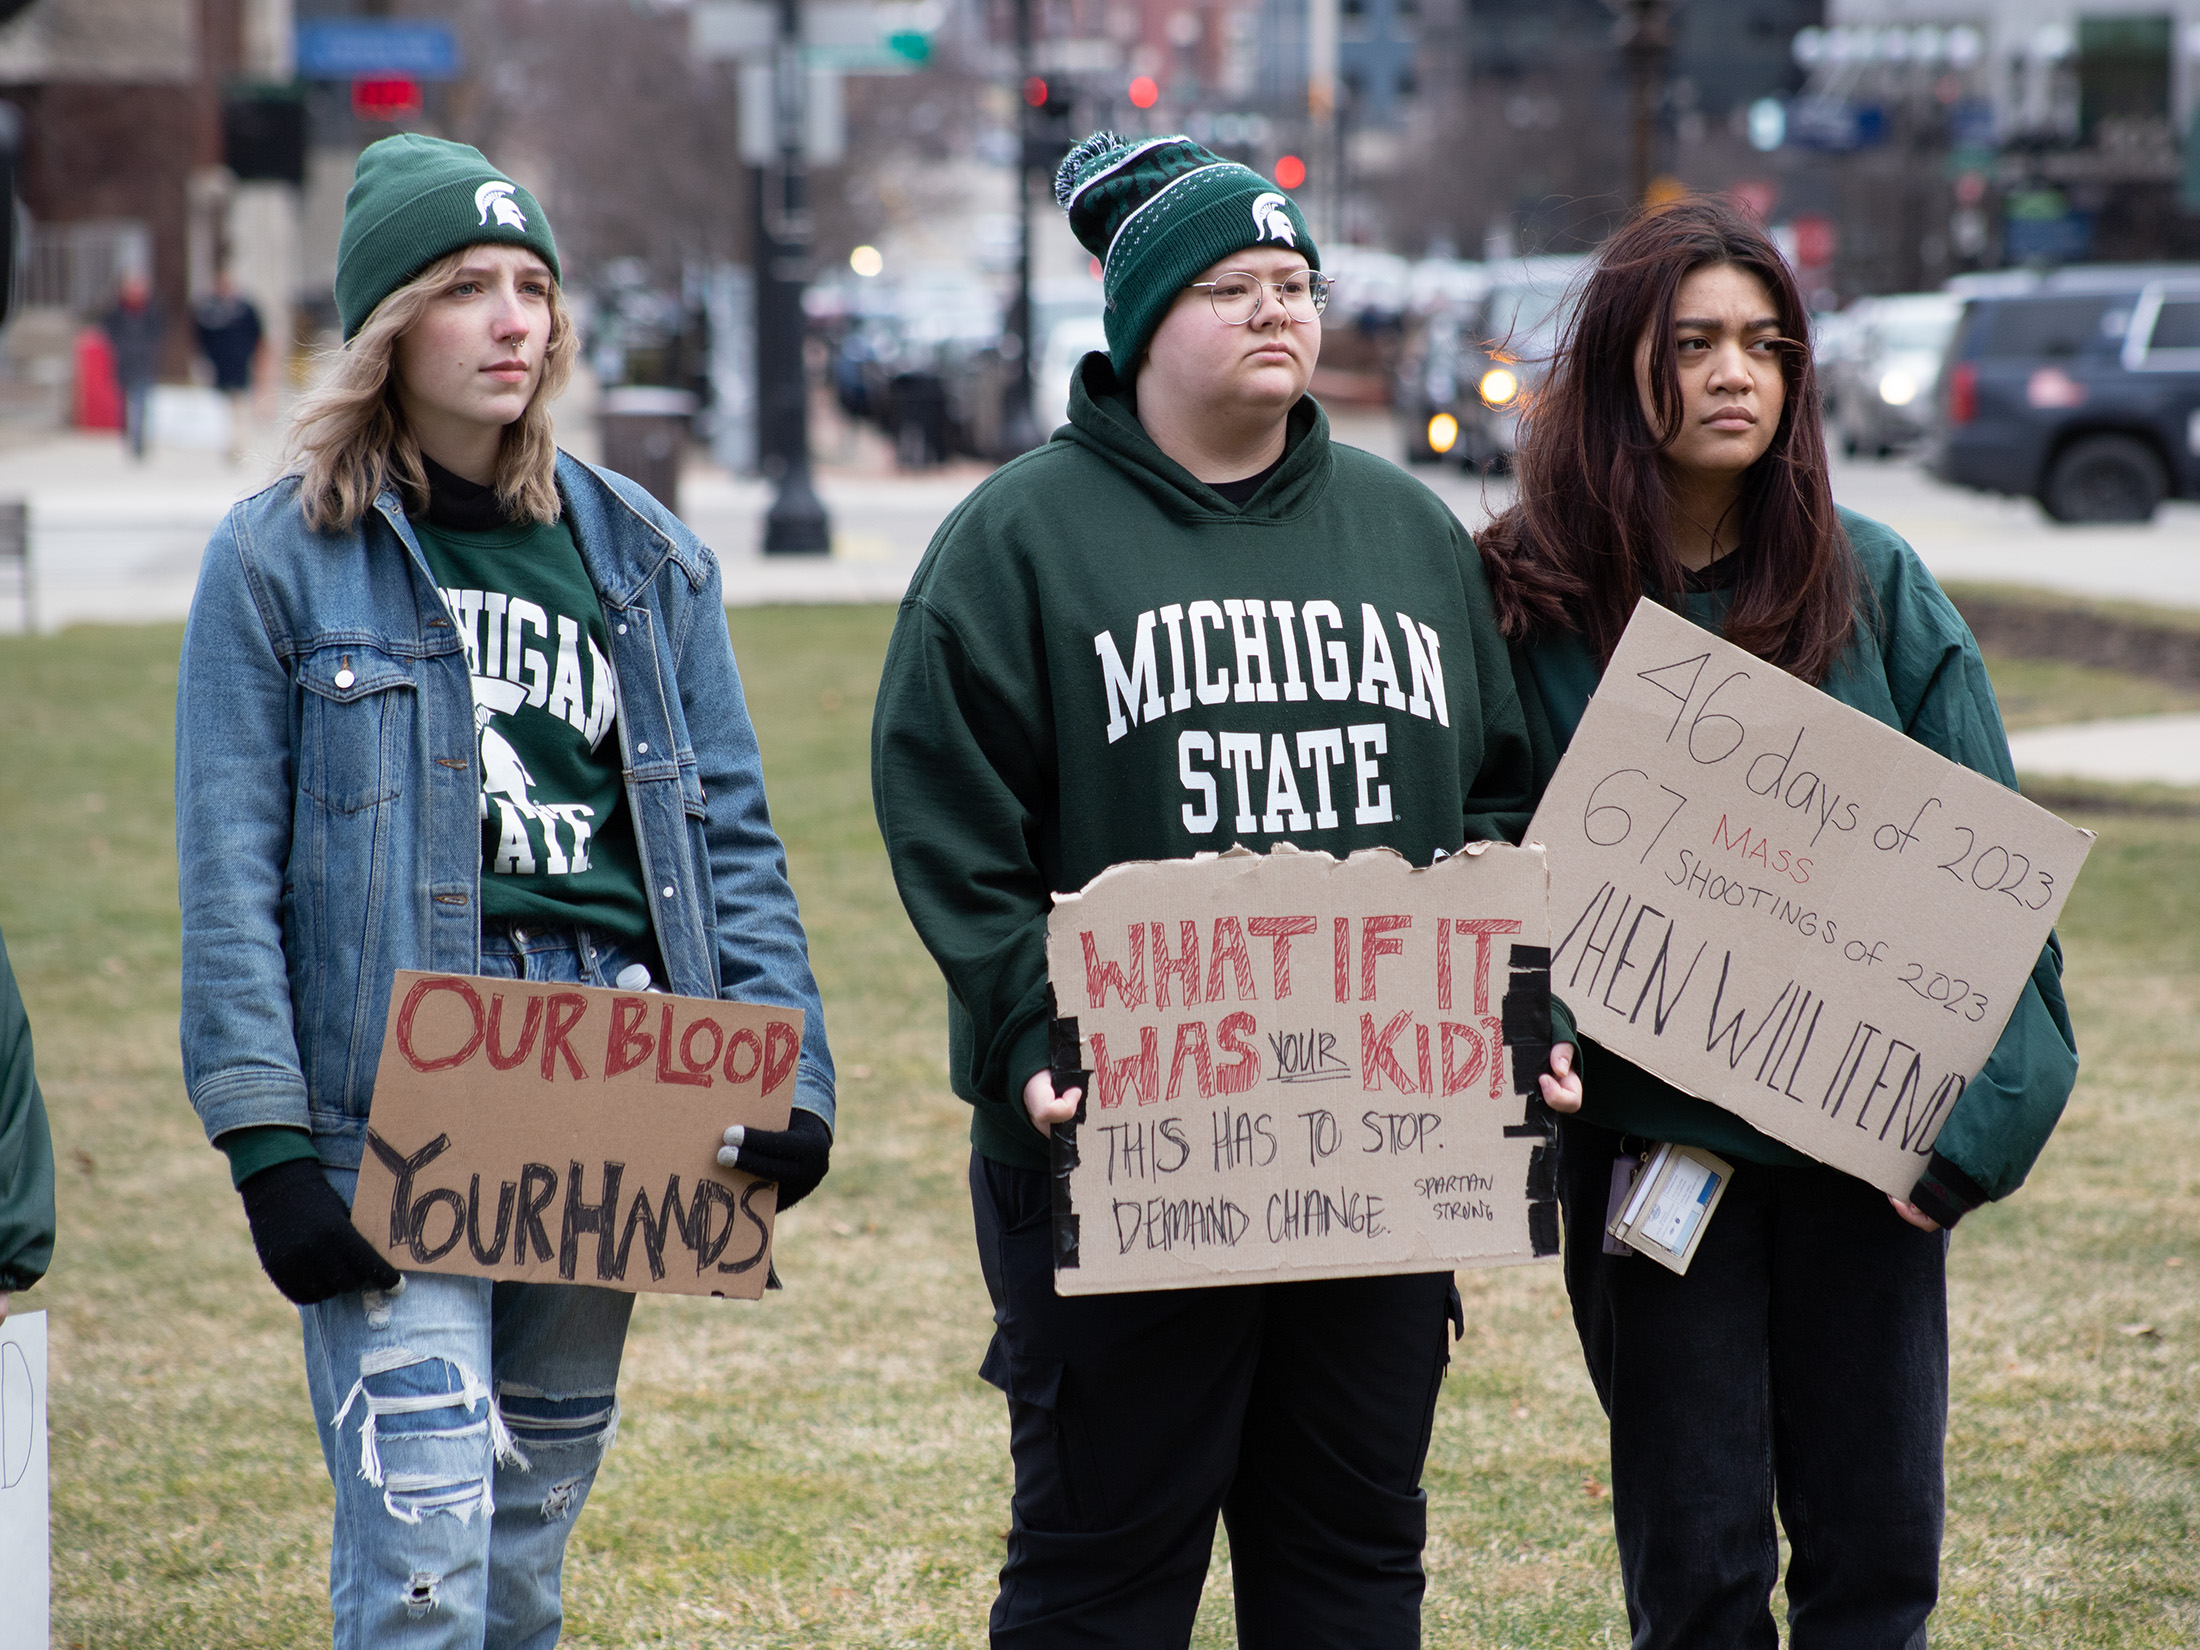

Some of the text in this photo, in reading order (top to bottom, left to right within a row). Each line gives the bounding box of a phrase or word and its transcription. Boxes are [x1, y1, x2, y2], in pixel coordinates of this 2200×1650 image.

[438, 587, 616, 755] HIGAN
[1094, 599, 1450, 744] MICHIGAN
[1178, 723, 1393, 834] STATE
[1584, 769, 1814, 885] 67 MASS
[1637, 653, 2055, 911] 46 days of 2023
[1080, 914, 1522, 1016] WHAT IF IT
[1551, 881, 1708, 1037] HEN
[1706, 951, 1824, 1103] WILL
[1664, 849, 1989, 1022] SHOOTINGS of 2023
[397, 977, 801, 1098] OUR BLOOD
[1089, 1010, 1507, 1108] WAS YOUR KID?
[1097, 1106, 1445, 1185] THIS HAS TO STOP.
[1414, 1174, 1495, 1198] SPARTAN
[1112, 1186, 1393, 1254] DEMAND CHANGE.
[1433, 1199, 1495, 1222] STRONG
